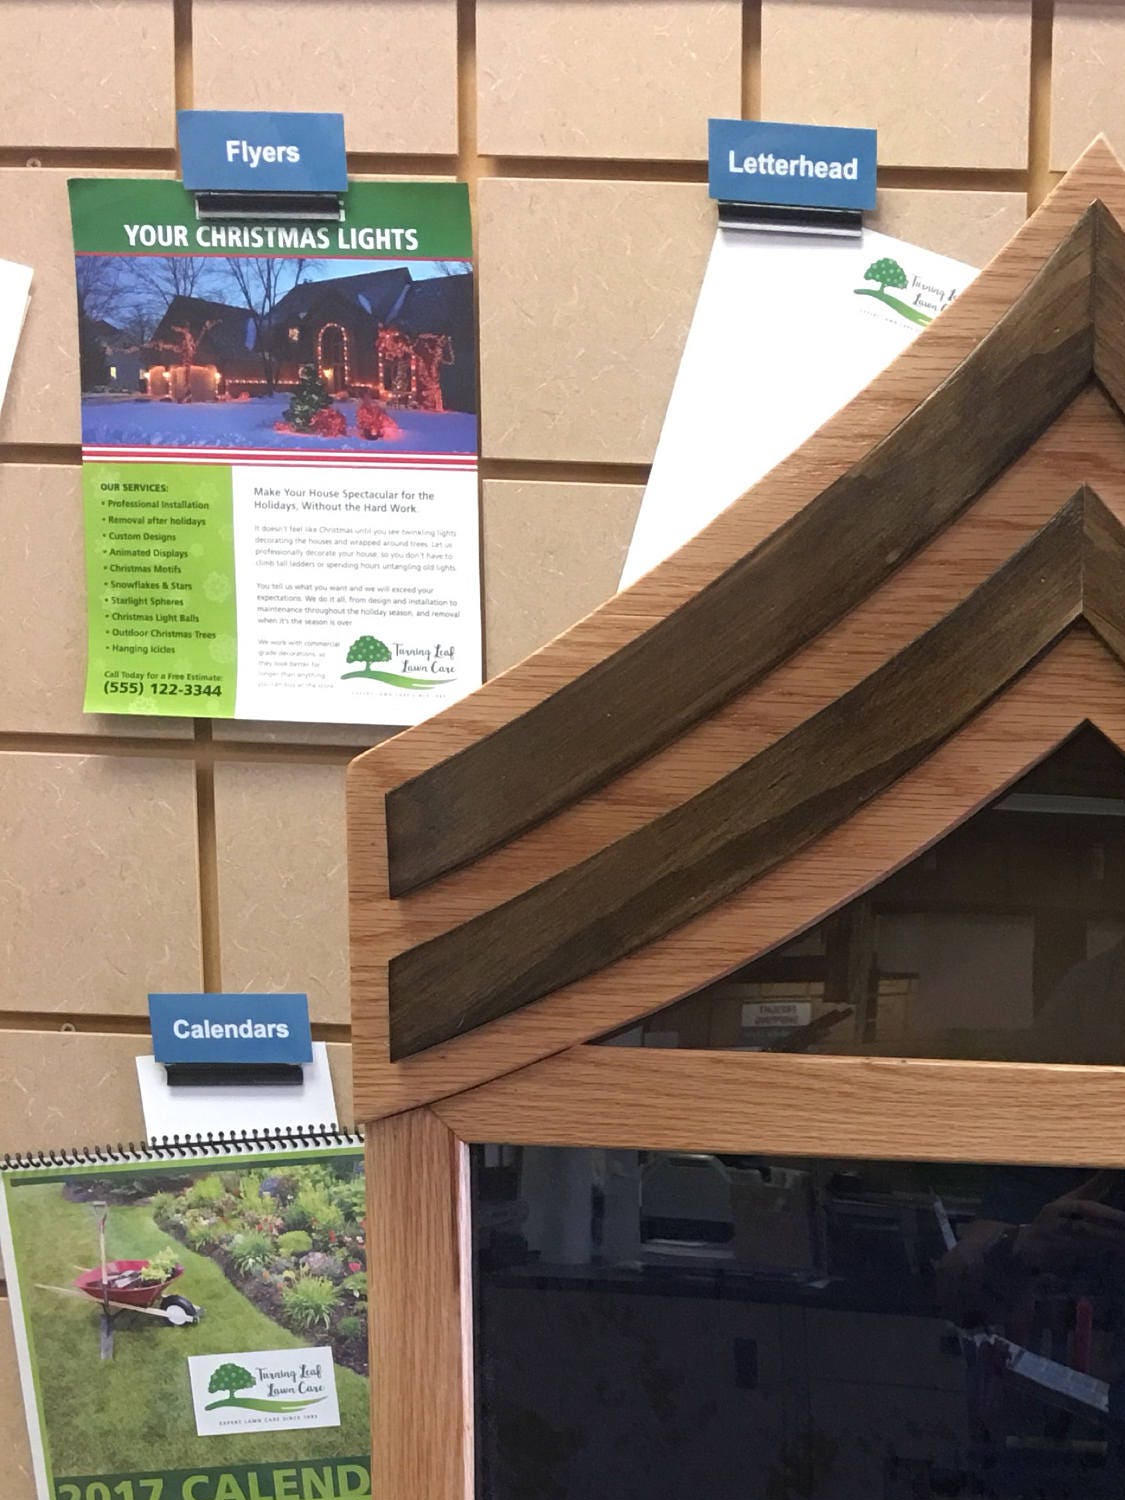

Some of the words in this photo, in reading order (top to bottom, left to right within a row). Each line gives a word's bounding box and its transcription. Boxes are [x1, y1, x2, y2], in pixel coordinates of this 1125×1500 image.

[225, 140, 301, 168] Flyers
[729, 150, 858, 180] Letterhead
[124, 224, 189, 247] YOUR
[196, 225, 329, 249] CHRISTMAS
[338, 228, 418, 251] LIGHTS
[101, 483, 120, 492] OUR
[254, 488, 281, 496] Make
[284, 488, 306, 497] Your
[309, 489, 340, 498] House
[342, 490, 398, 499] Spectacular
[401, 491, 415, 500] for
[418, 491, 435, 500] the
[108, 500, 159, 509] Professional
[162, 501, 209, 510] Installation
[302, 501, 342, 511] Without
[345, 502, 360, 511] the
[364, 503, 387, 512] Hard
[108, 516, 145, 524] Removal
[147, 517, 167, 525] after
[170, 517, 206, 527] holidays
[109, 532, 141, 541] Custom
[143, 533, 176, 542] Designs
[109, 548, 151, 557] Animated
[153, 549, 188, 559] Displays
[110, 565, 151, 573] Christmas
[154, 565, 181, 574] Motifs
[110, 580, 160, 589] Snowflakes
[162, 581, 169, 589] &
[171, 581, 192, 590] Stars
[111, 596, 147, 607] Starlight
[150, 597, 184, 607] Spheres
[112, 612, 153, 622] Christmas
[155, 613, 177, 623] Light
[112, 628, 148, 637] Outdoor
[151, 629, 192, 639] Christmas
[195, 631, 216, 639] Trees
[113, 644, 148, 655] Hanging
[151, 645, 175, 654] Icicles
[392, 643, 430, 661] Turning
[435, 643, 455, 660] Leaf
[402, 660, 428, 673] Lawn
[430, 660, 456, 674] Care
[104, 670, 119, 678] Call
[122, 671, 144, 680] Today
[167, 672, 185, 680] Free
[103, 681, 144, 696] (555)
[150, 683, 222, 697] 122-3344
[173, 1018, 290, 1040] Calendars
[256, 1367, 296, 1383] Turning
[299, 1364, 322, 1379] Leaf
[267, 1383, 296, 1397] Lawn
[298, 1381, 324, 1394] Care
